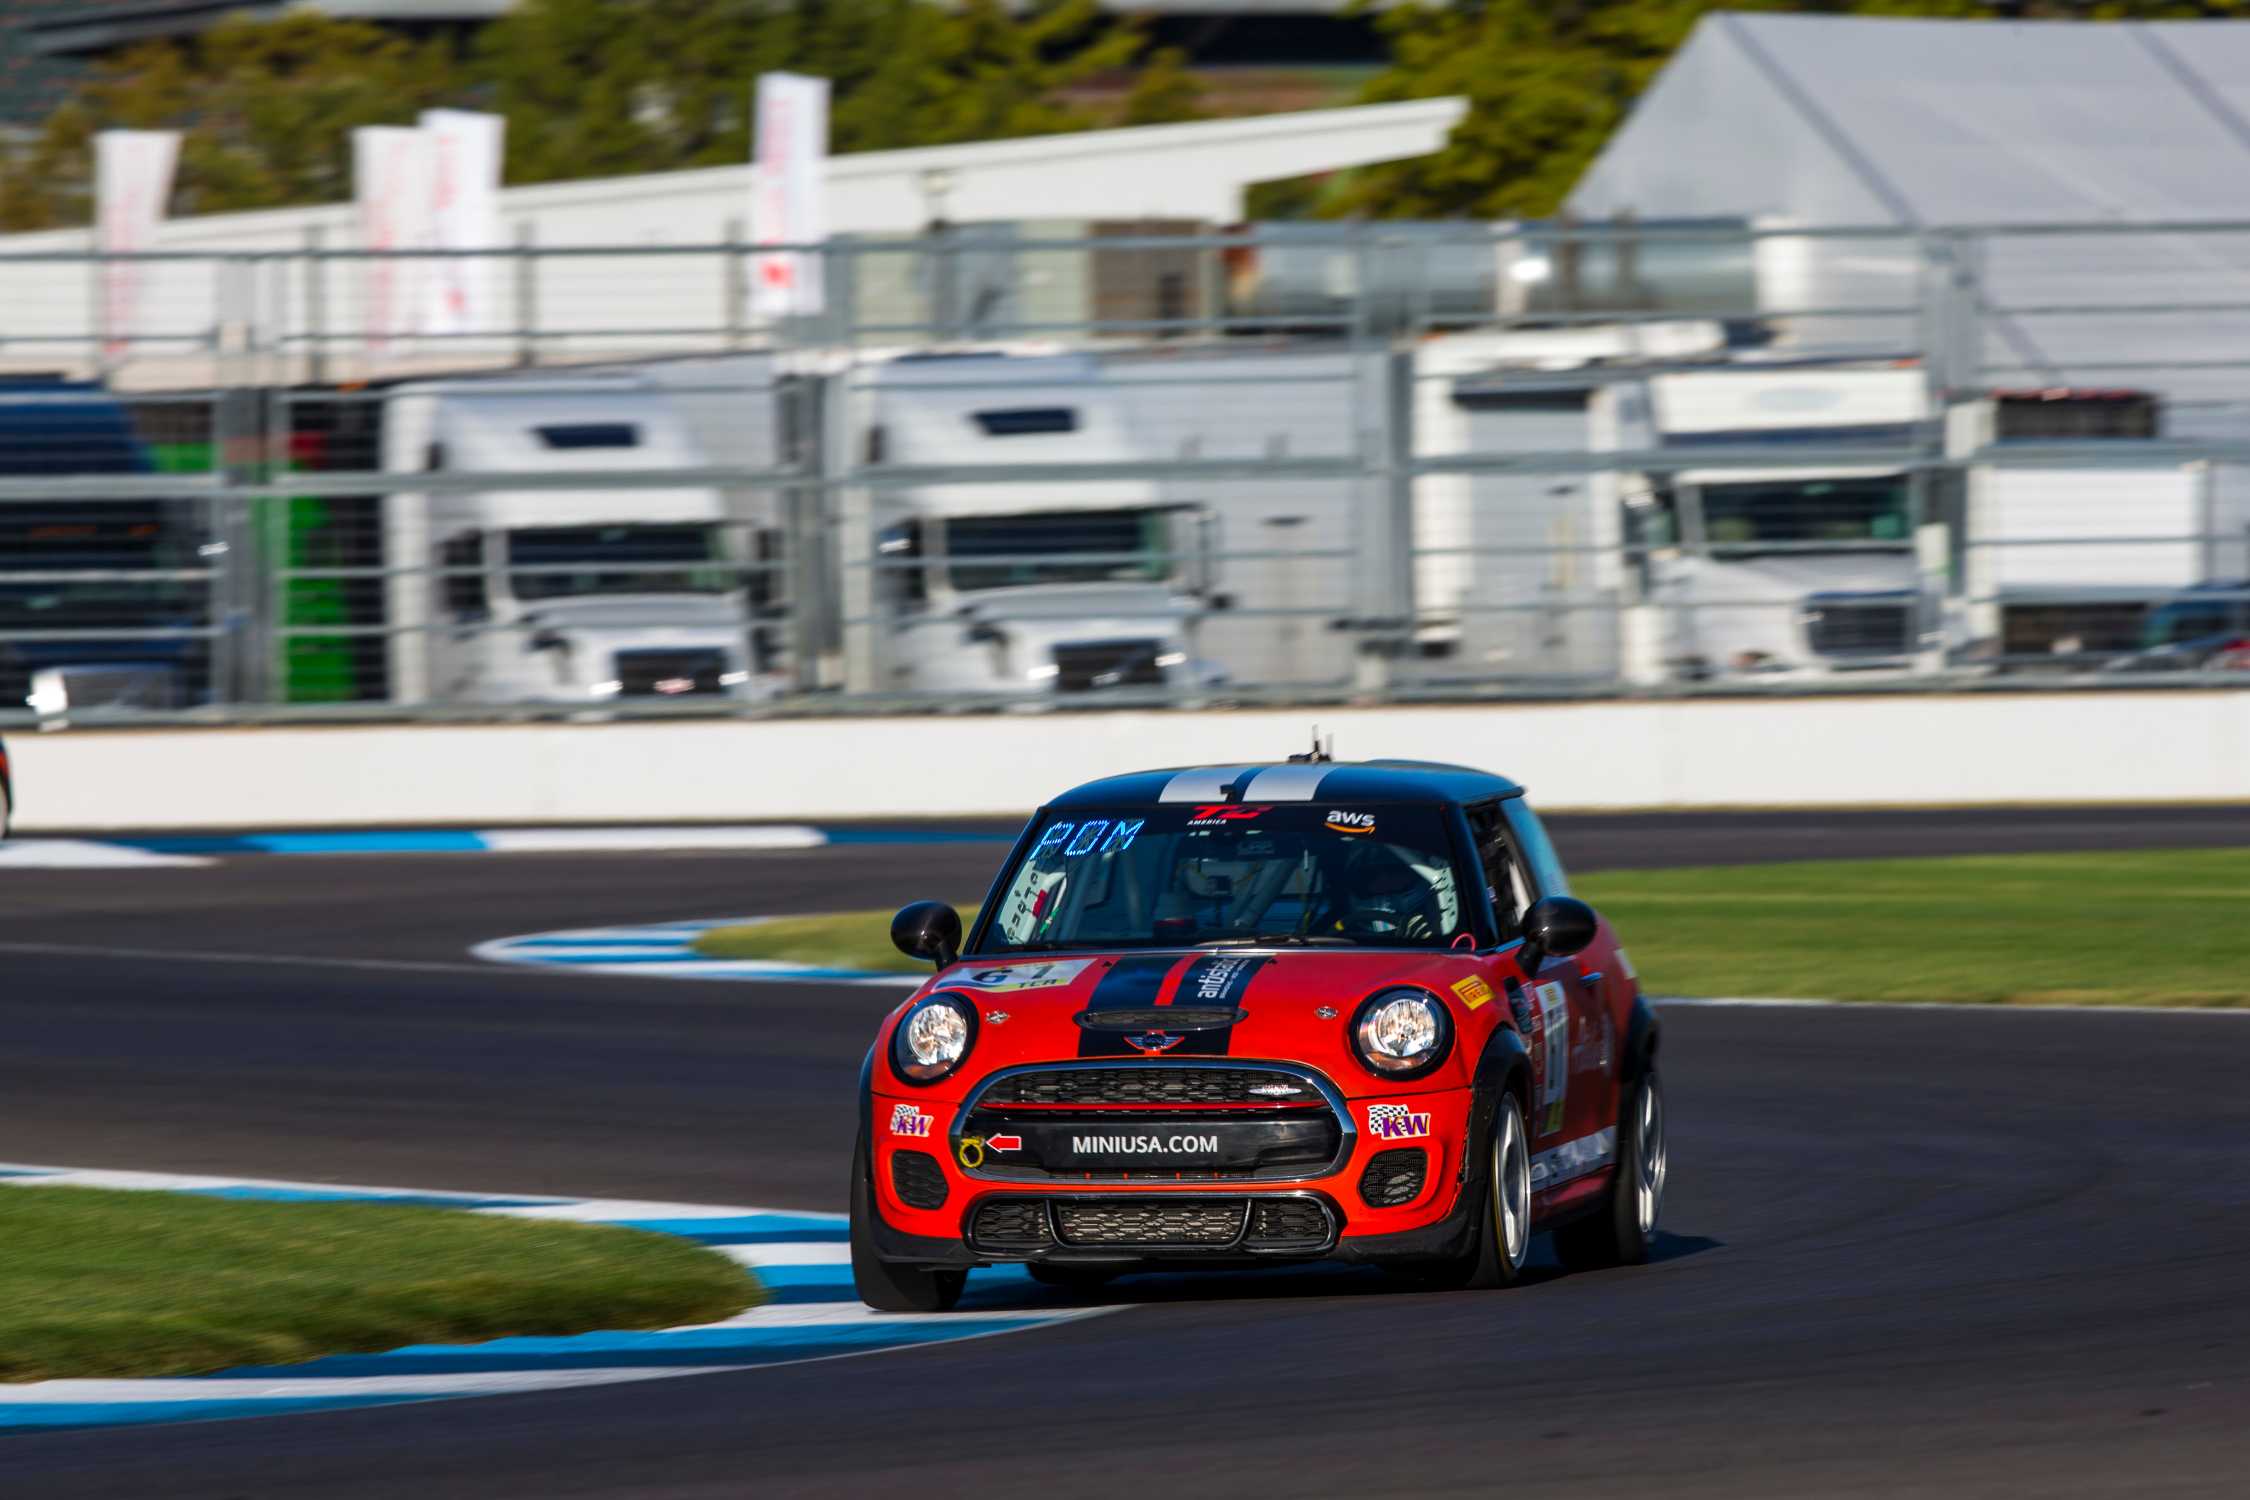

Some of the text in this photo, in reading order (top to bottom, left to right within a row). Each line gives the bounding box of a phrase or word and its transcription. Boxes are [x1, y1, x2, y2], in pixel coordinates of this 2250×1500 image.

[1187, 818, 1228, 826] AMERICA
[1326, 808, 1376, 827] aws
[972, 965, 1055, 984] 61
[1018, 979, 1057, 988] TCA
[1382, 1115, 1429, 1138] KW
[1072, 1135, 1218, 1154] MINIUSA.COM
